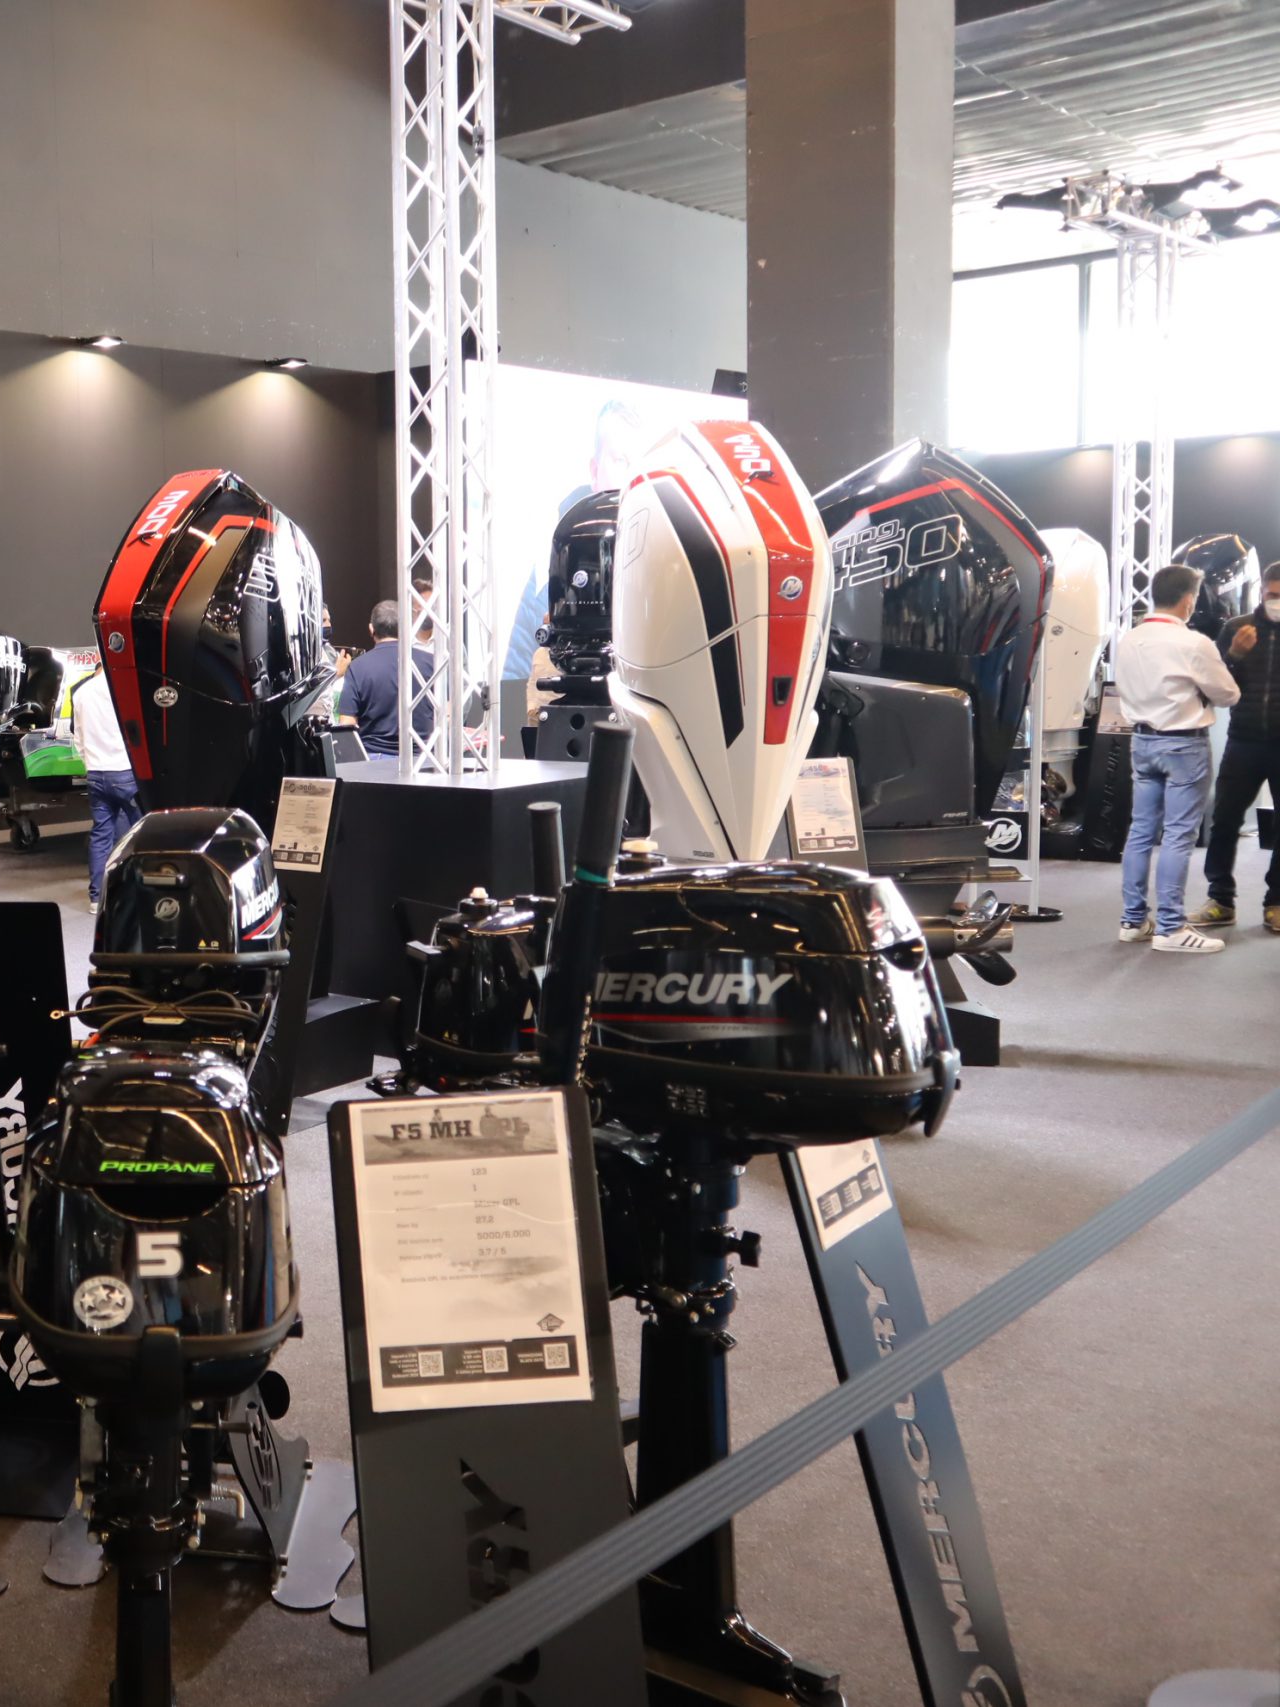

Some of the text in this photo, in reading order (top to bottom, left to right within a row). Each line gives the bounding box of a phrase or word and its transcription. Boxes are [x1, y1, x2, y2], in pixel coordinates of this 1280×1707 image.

[831, 519, 900, 553] cing
[594, 972, 794, 1006] ERCURY
[390, 1124, 422, 1141] F5
[428, 1119, 473, 1140] MH
[99, 1160, 216, 1174] PROPANE
[471, 1167, 487, 1177] 123
[136, 1231, 183, 1279] 5
